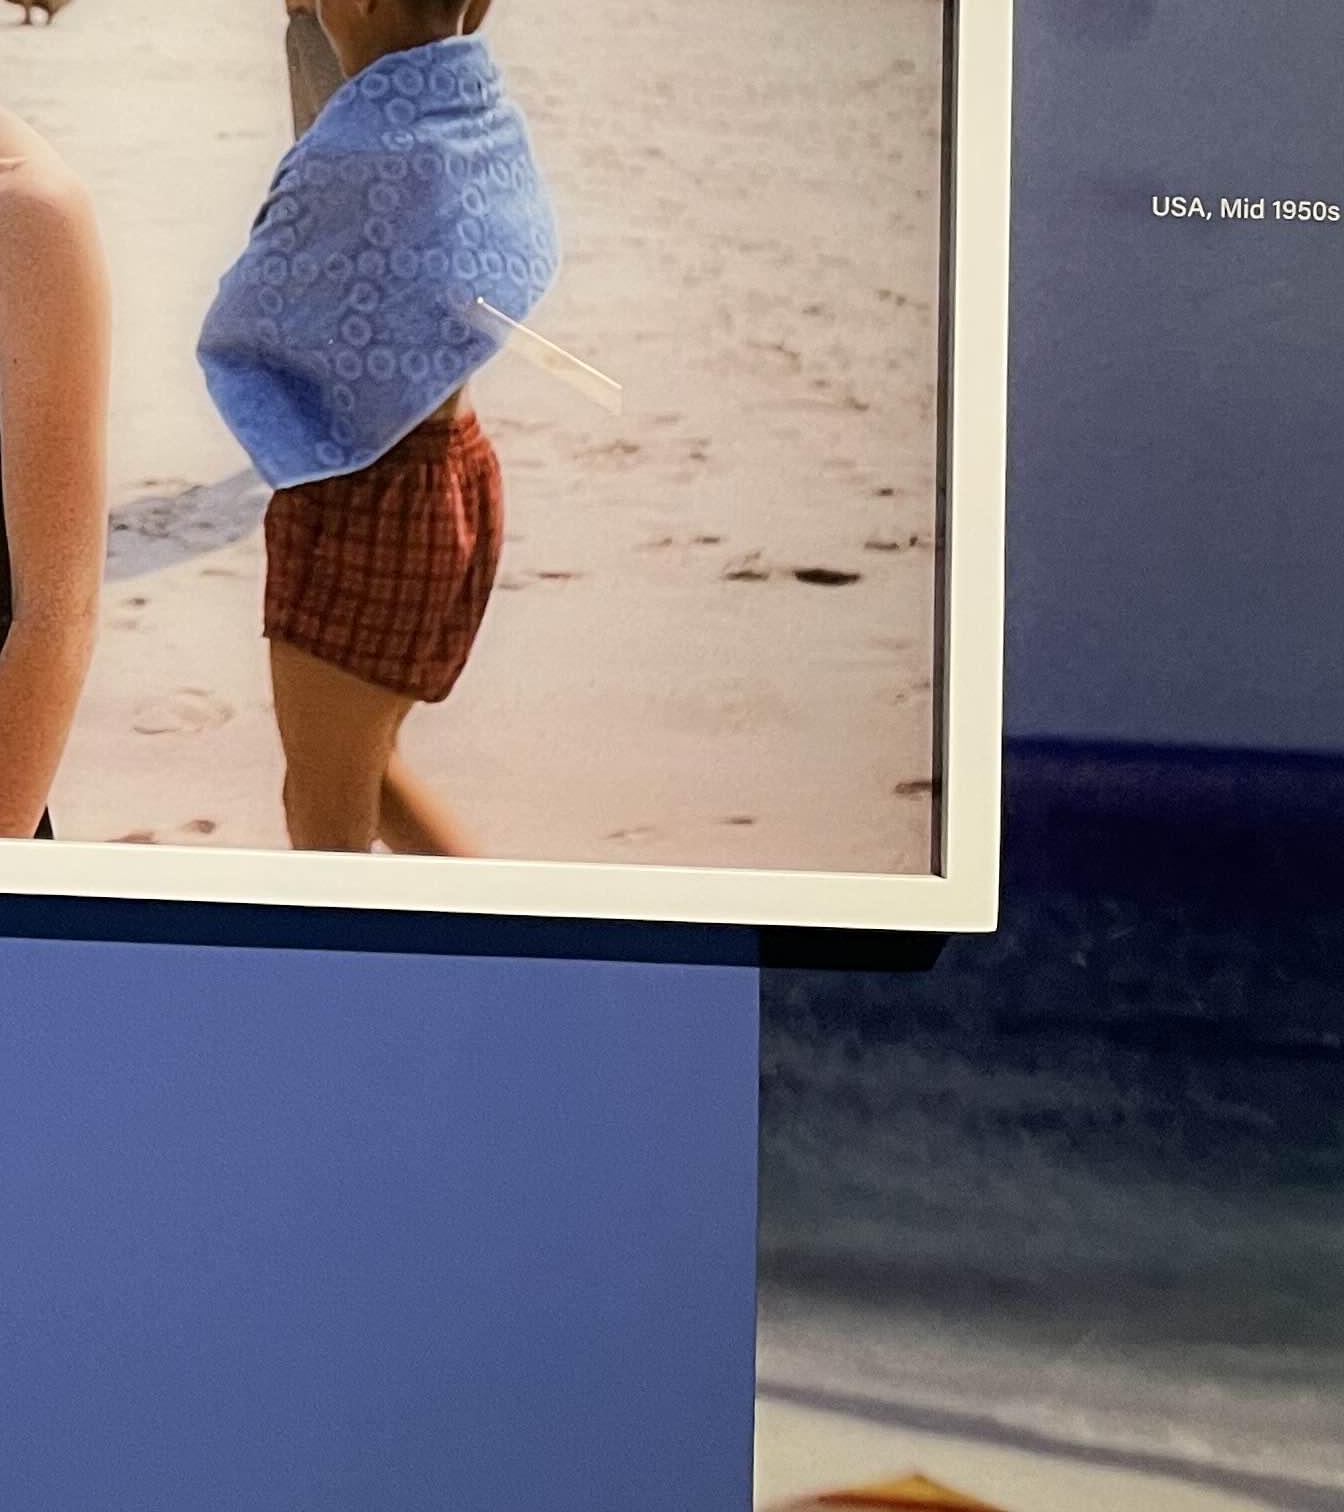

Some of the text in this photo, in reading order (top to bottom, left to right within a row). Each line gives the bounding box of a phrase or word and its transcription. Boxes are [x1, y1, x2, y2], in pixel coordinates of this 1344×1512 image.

[1152, 196, 1342, 222] USA, Mid 1950s
